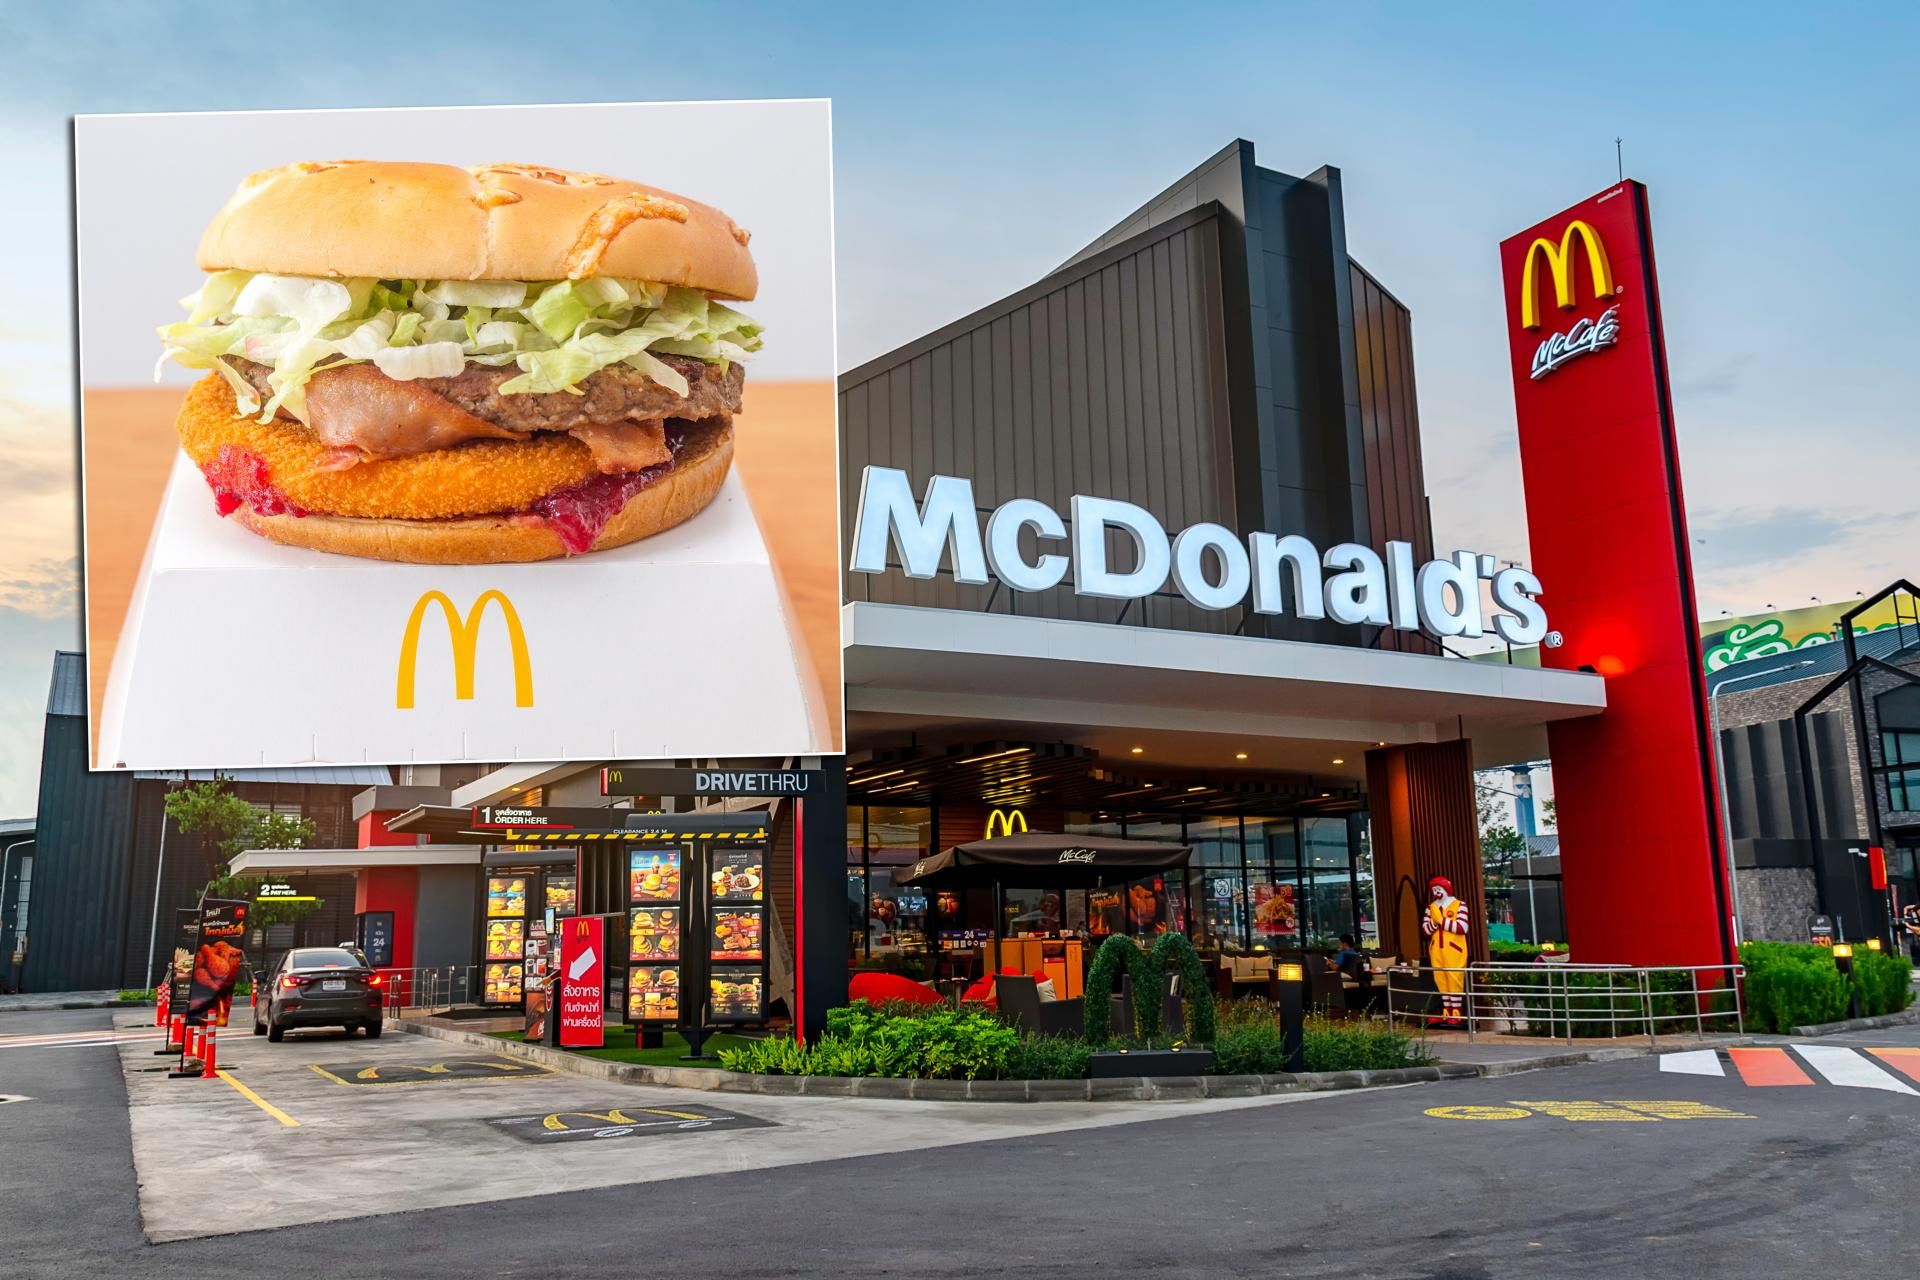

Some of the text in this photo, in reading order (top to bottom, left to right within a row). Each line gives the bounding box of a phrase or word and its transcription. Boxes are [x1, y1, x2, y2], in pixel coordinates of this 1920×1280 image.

[1530, 303, 1621, 380] McCafé
[481, 806, 491, 823] 1
[494, 816, 524, 824] ORDER
[260, 884, 270, 895] 2
[964, 930, 974, 940] 24
[373, 938, 385, 947] 24
[562, 980, 600, 997] สั่งอาหาร
[564, 1000, 599, 1013] กับเจ้าหน้าที่
[562, 1015, 601, 1028] ผ่านเครื่องนี้
